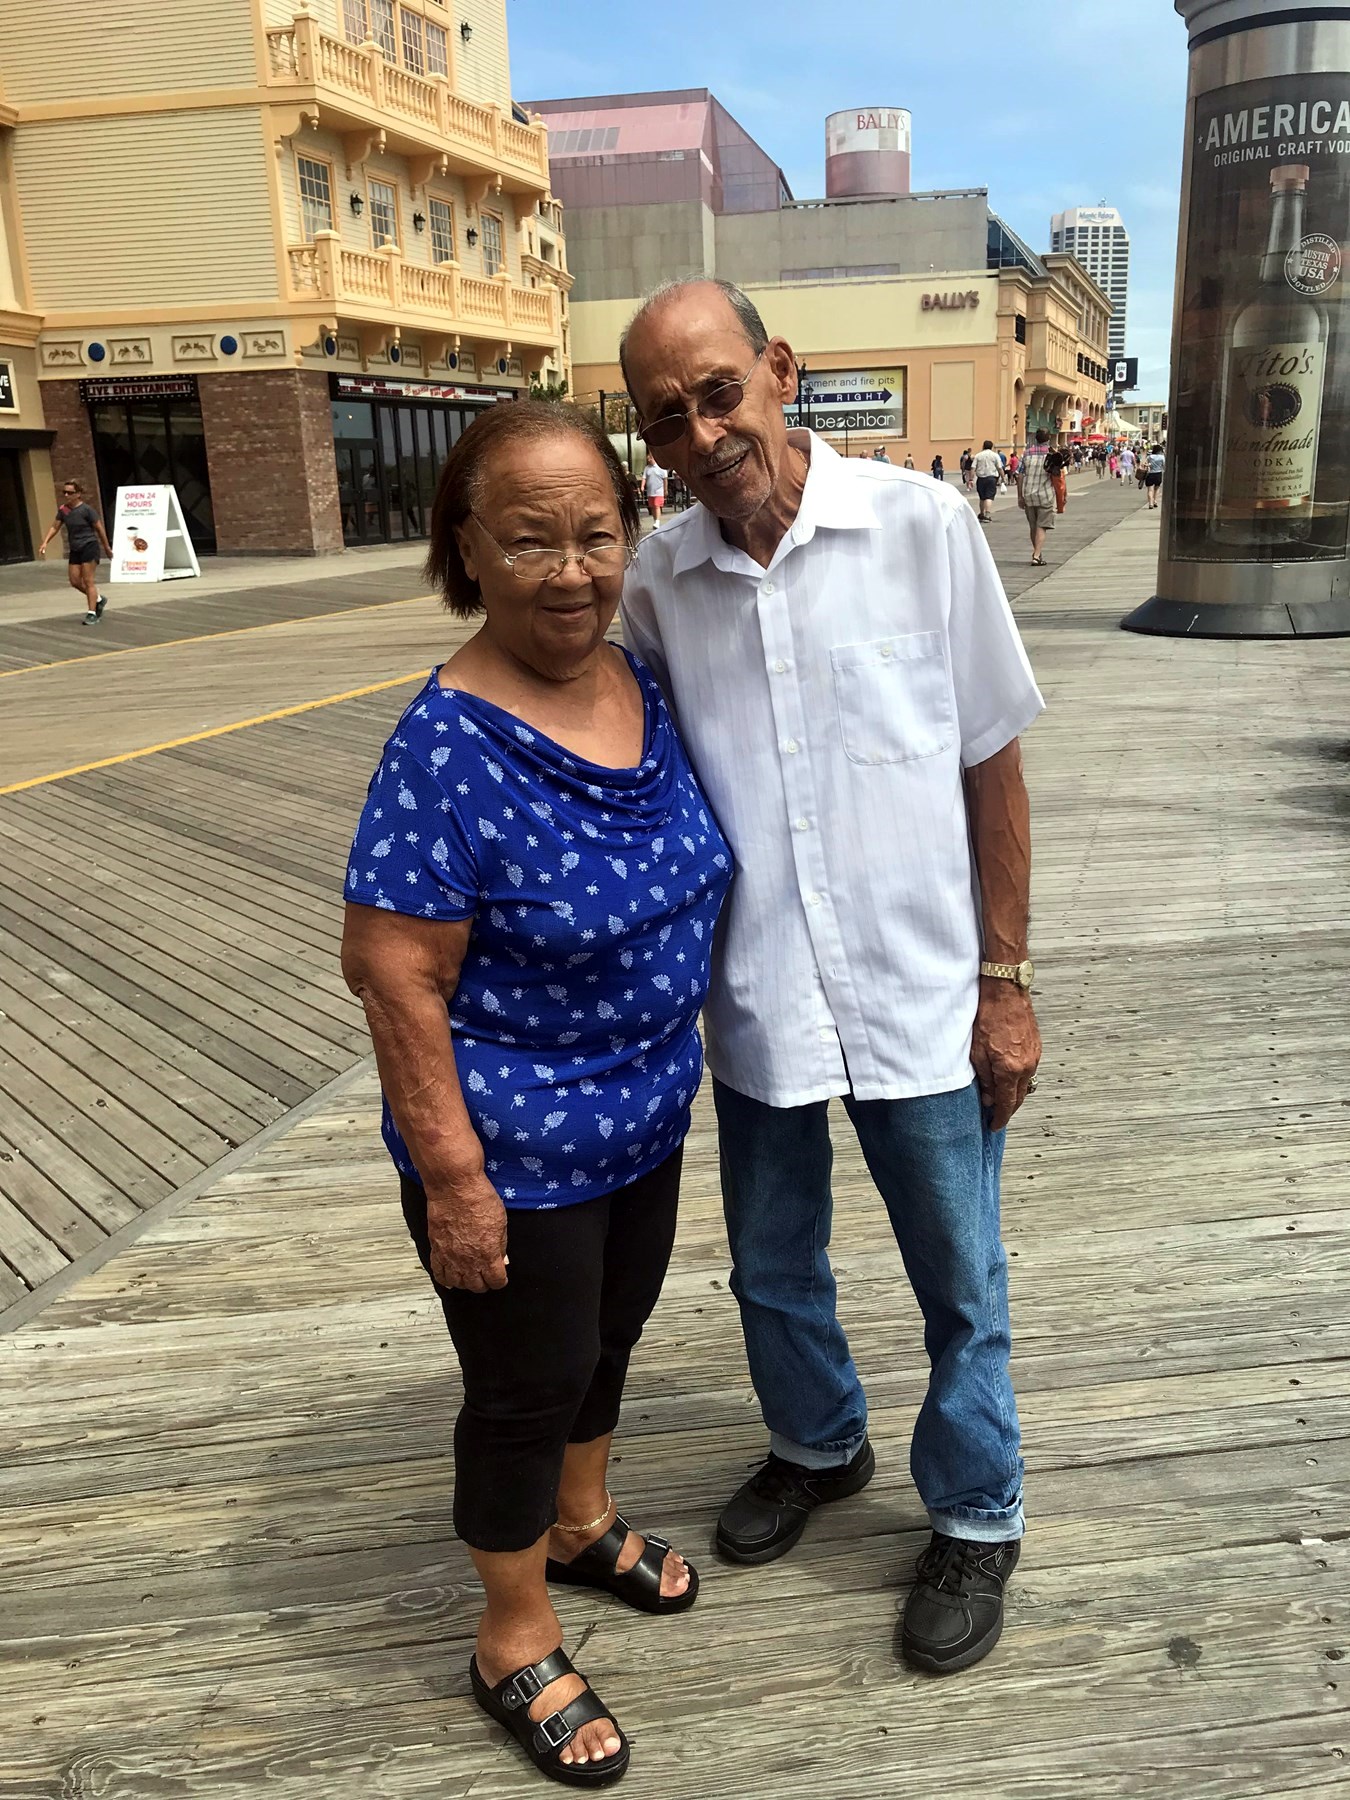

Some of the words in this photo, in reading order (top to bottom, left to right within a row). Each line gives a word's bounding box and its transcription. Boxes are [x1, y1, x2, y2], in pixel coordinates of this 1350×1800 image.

[1205, 100, 1350, 151] AMERICA
[1213, 145, 1272, 167] ORIGINAL
[1277, 141, 1323, 156] CRAFT
[1301, 237, 1336, 253] DISTILLED
[1302, 249, 1331, 262] AUSTIN
[1301, 258, 1328, 269] TEXAS
[1299, 266, 1325, 280] USA
[1291, 276, 1326, 292] BOTTLED
[840, 378, 857, 386] and
[860, 377, 874, 385] fire
[878, 377, 895, 386] pits
[88, 386, 109, 395] LIVE
[113, 382, 189, 394] ENTERTAINMENT
[836, 392, 882, 402] RIGHT
